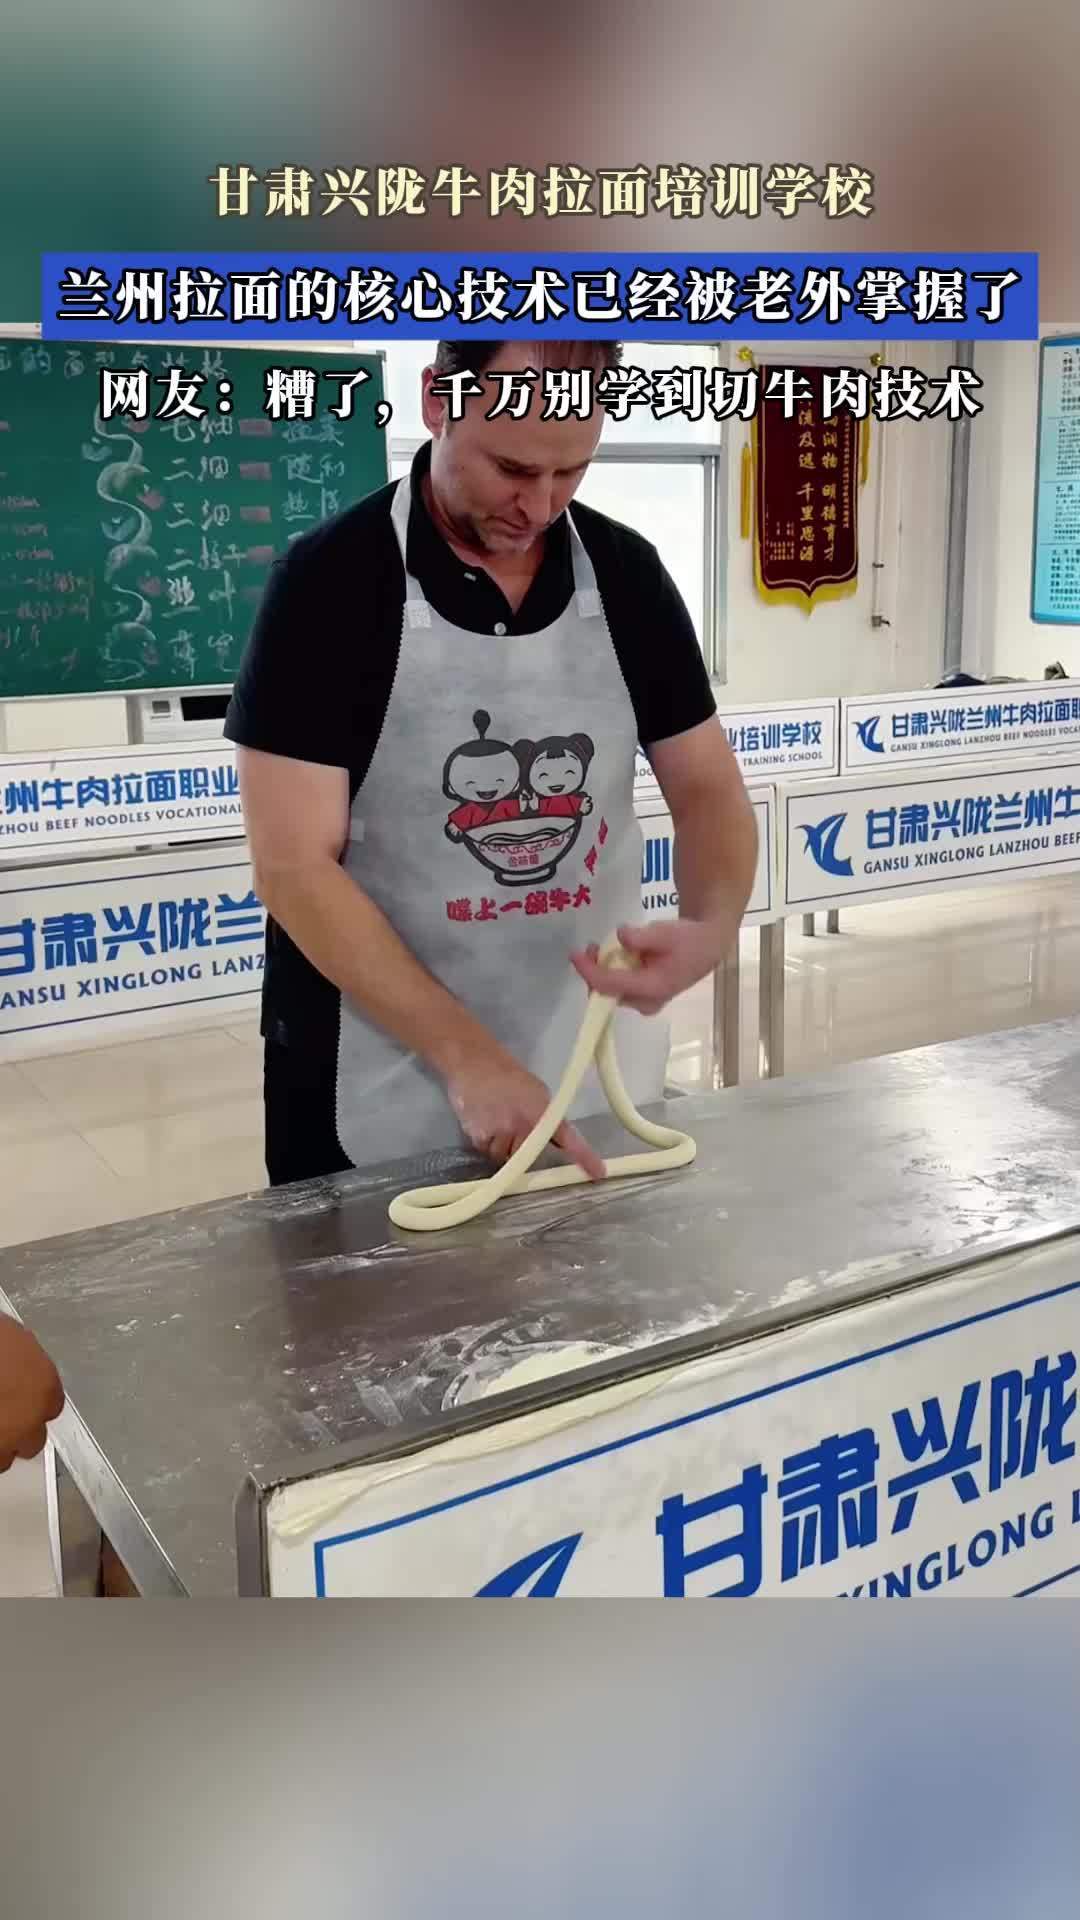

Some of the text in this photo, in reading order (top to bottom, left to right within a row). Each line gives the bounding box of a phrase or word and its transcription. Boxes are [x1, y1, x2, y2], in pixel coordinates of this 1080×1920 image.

[743, 751, 823, 767] TRAINING SCHOOL
[920, 737, 962, 749] XINGLONG
[963, 733, 1001, 745] LANZHOU
[0, 765, 239, 816] 州牛肉拉面职业
[45, 817, 80, 832] BEEF
[84, 811, 151, 828] NOODLES
[865, 785, 1080, 851] 甘肃兴陇兰州牛
[863, 858, 909, 875] GANSU
[914, 846, 985, 868] XINGLONG
[988, 836, 1049, 857] LANZHOU
[77, 963, 203, 998] XINGLONG
[655, 1350, 1079, 1598] 甘肃兴陇
